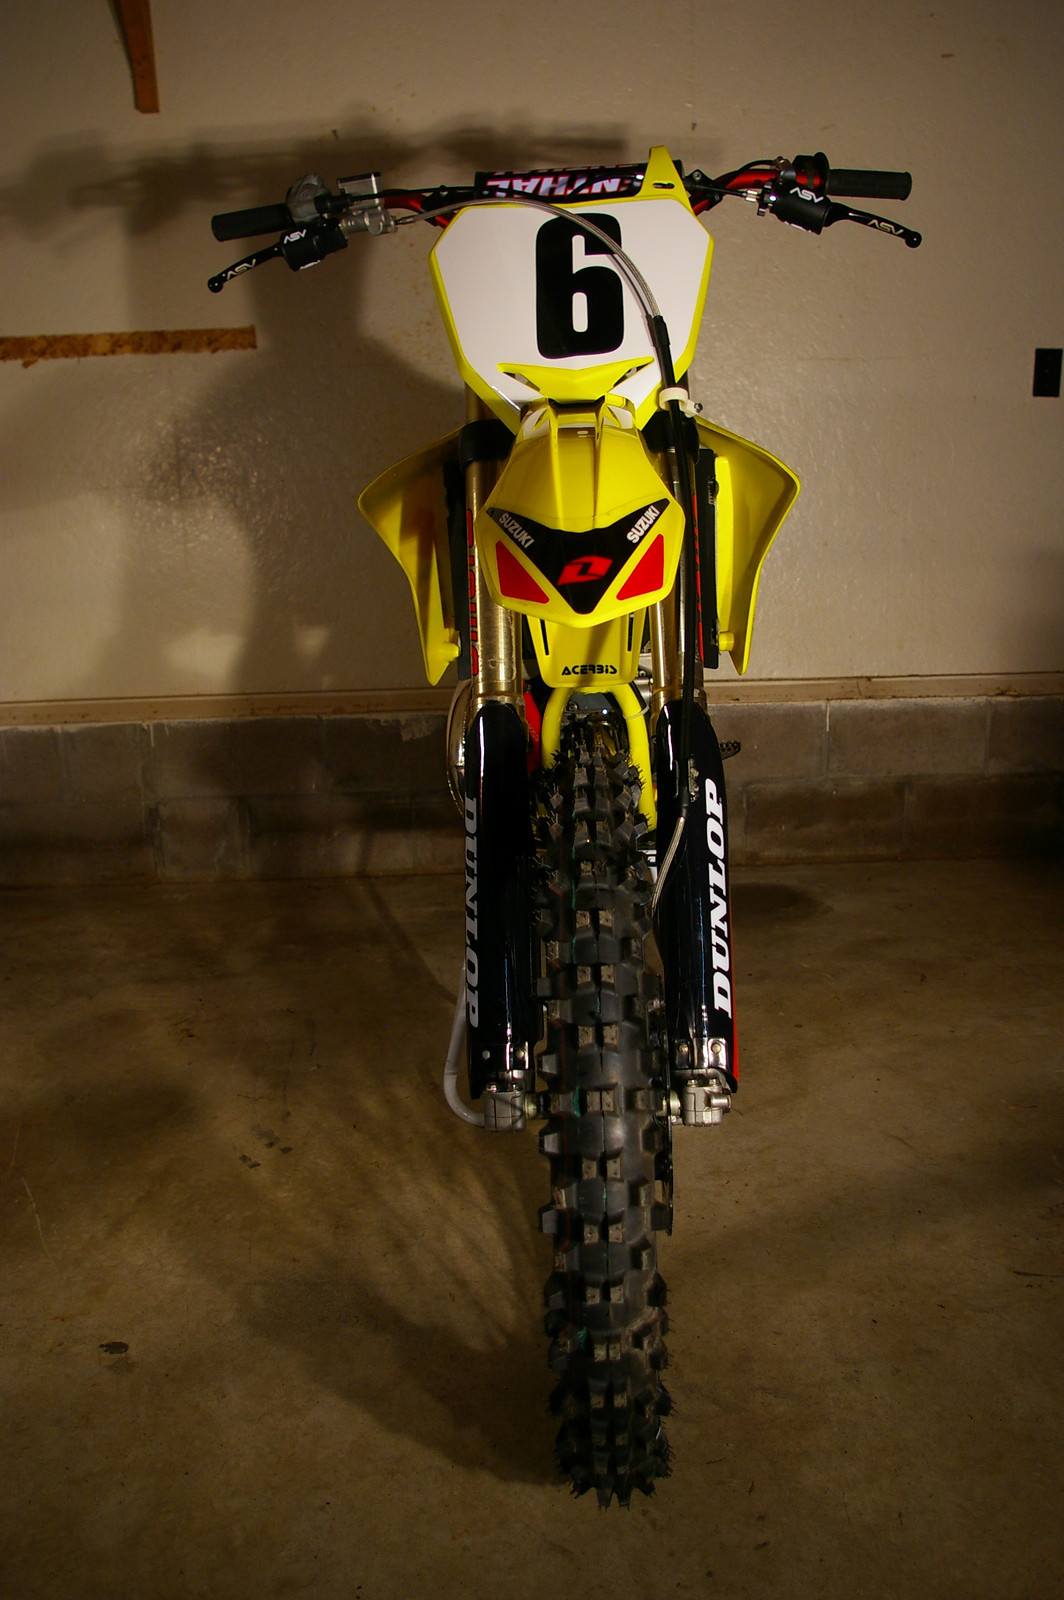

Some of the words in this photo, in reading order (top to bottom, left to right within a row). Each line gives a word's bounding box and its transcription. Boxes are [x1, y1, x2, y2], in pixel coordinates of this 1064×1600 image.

[789, 187, 824, 203] ASV
[283, 229, 307, 244] ASV
[867, 219, 904, 235] ASV
[226, 259, 256, 280] ASV
[536, 212, 624, 359] 6
[498, 512, 535, 549] SUZUKI
[626, 505, 660, 544] SUZUKI
[464, 796, 480, 1029] DUNLOP
[704, 777, 732, 1019] DUNLOP
